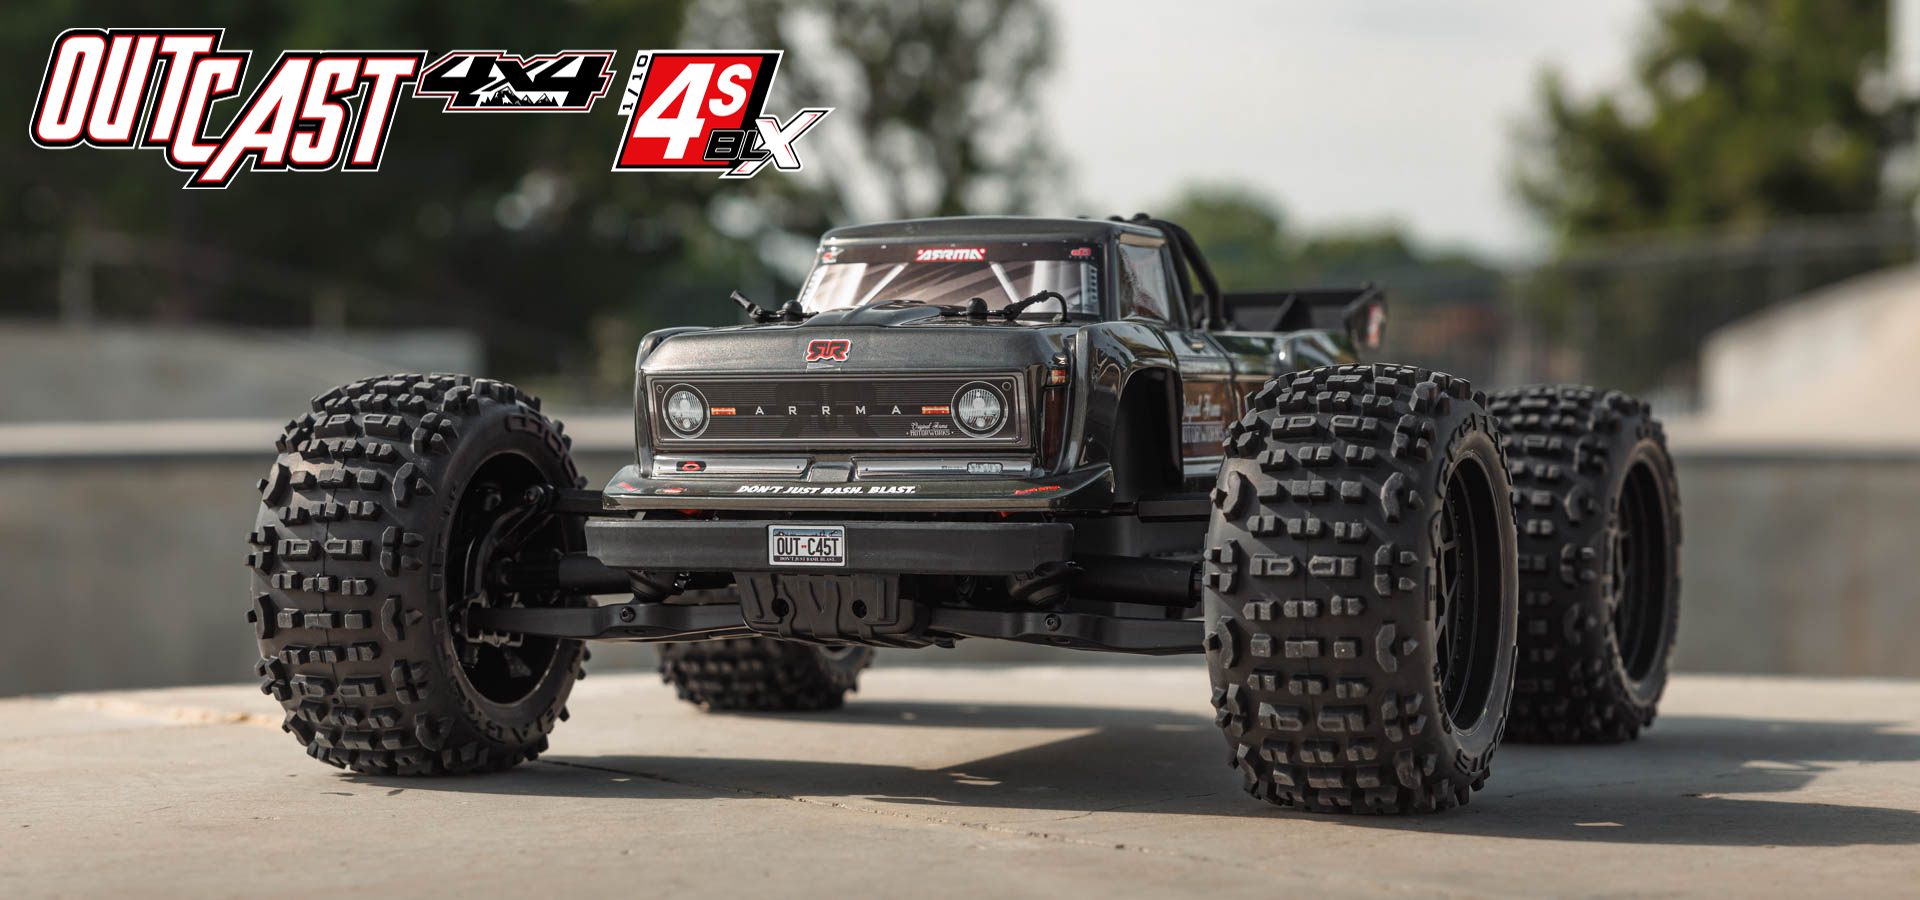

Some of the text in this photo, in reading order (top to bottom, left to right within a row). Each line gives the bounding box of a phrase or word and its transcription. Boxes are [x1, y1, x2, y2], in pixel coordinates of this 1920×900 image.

[755, 405, 901, 415] ARRMA
[736, 485, 916, 494] DON'T JUST BASH. BLAST.
